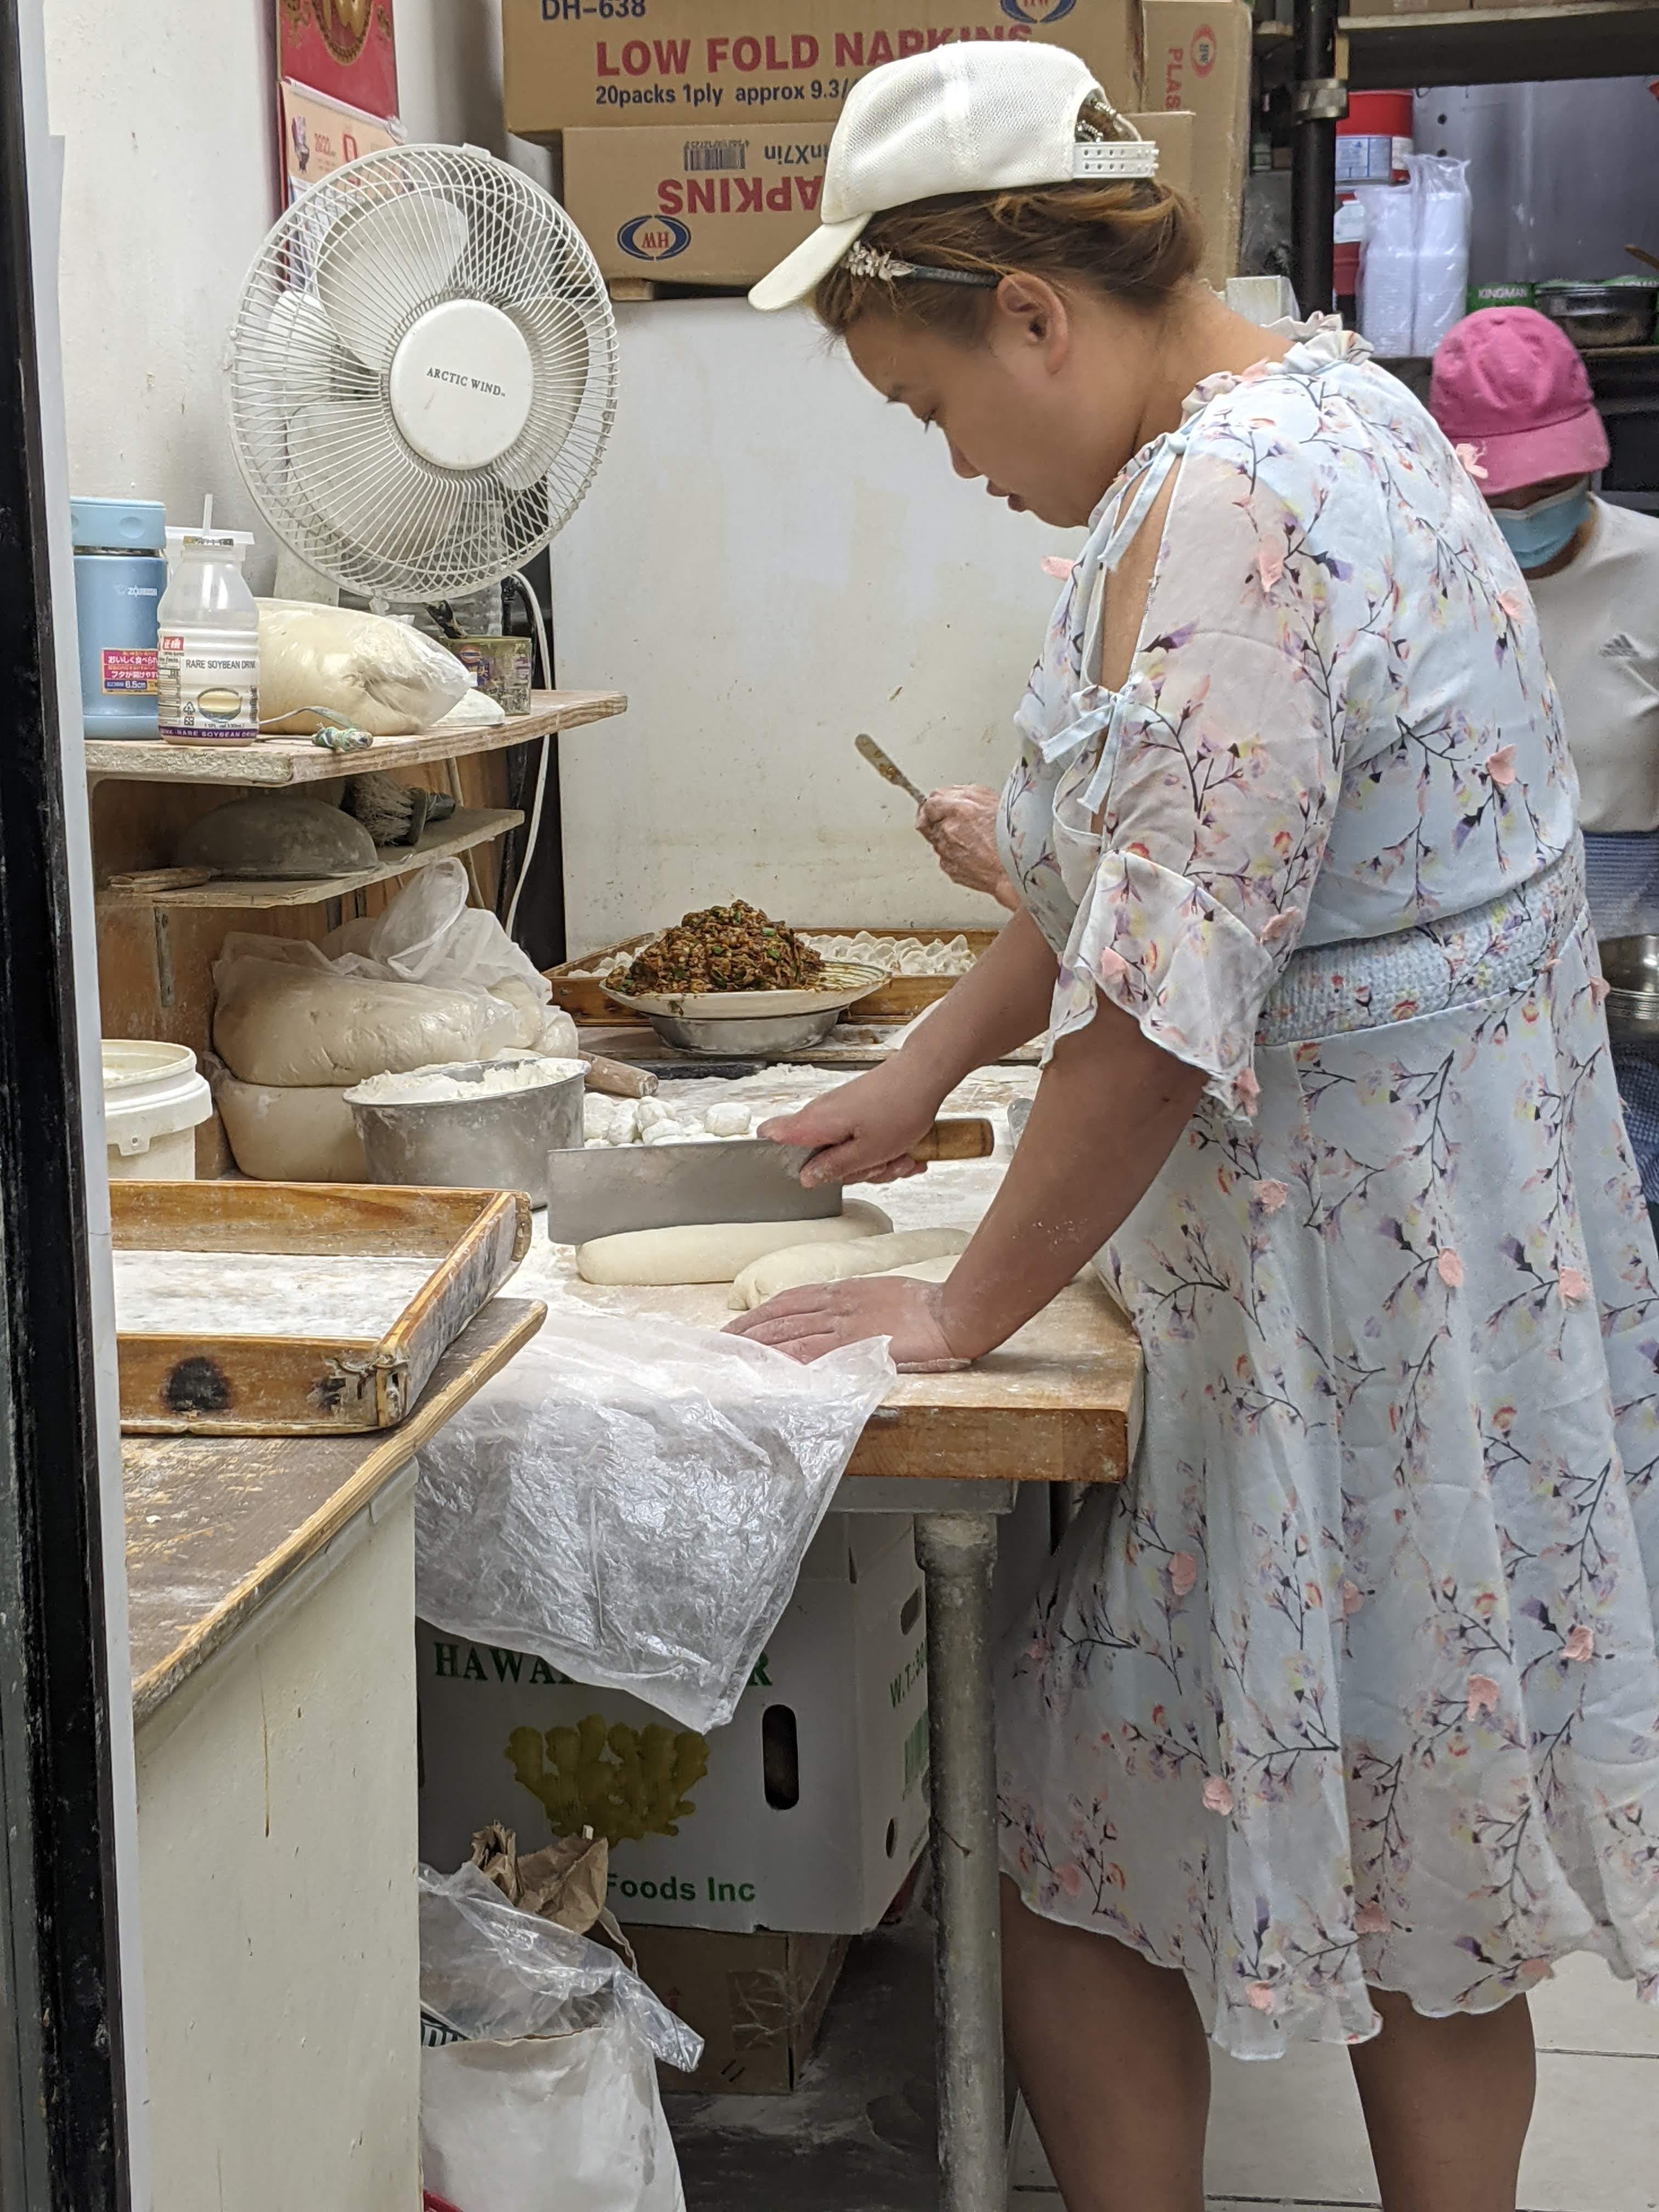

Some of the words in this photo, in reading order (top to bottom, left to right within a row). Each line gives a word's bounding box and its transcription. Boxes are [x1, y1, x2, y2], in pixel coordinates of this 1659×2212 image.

[542, 0, 646, 20] DH-638
[596, 39, 691, 77] LOW
[707, 34, 819, 73] FOLD
[596, 83, 676, 108] 20packs
[683, 82, 724, 107] 1ply
[735, 85, 805, 106] approx
[810, 78, 858, 100] 9.3/
[642, 232, 669, 249] HW
[427, 367, 468, 387] ARCTIC
[471, 378, 501, 396] WIND
[185, 659, 205, 669] RARE
[207, 660, 240, 669] SOYBEAN
[707, 1876, 756, 1901] Inc
